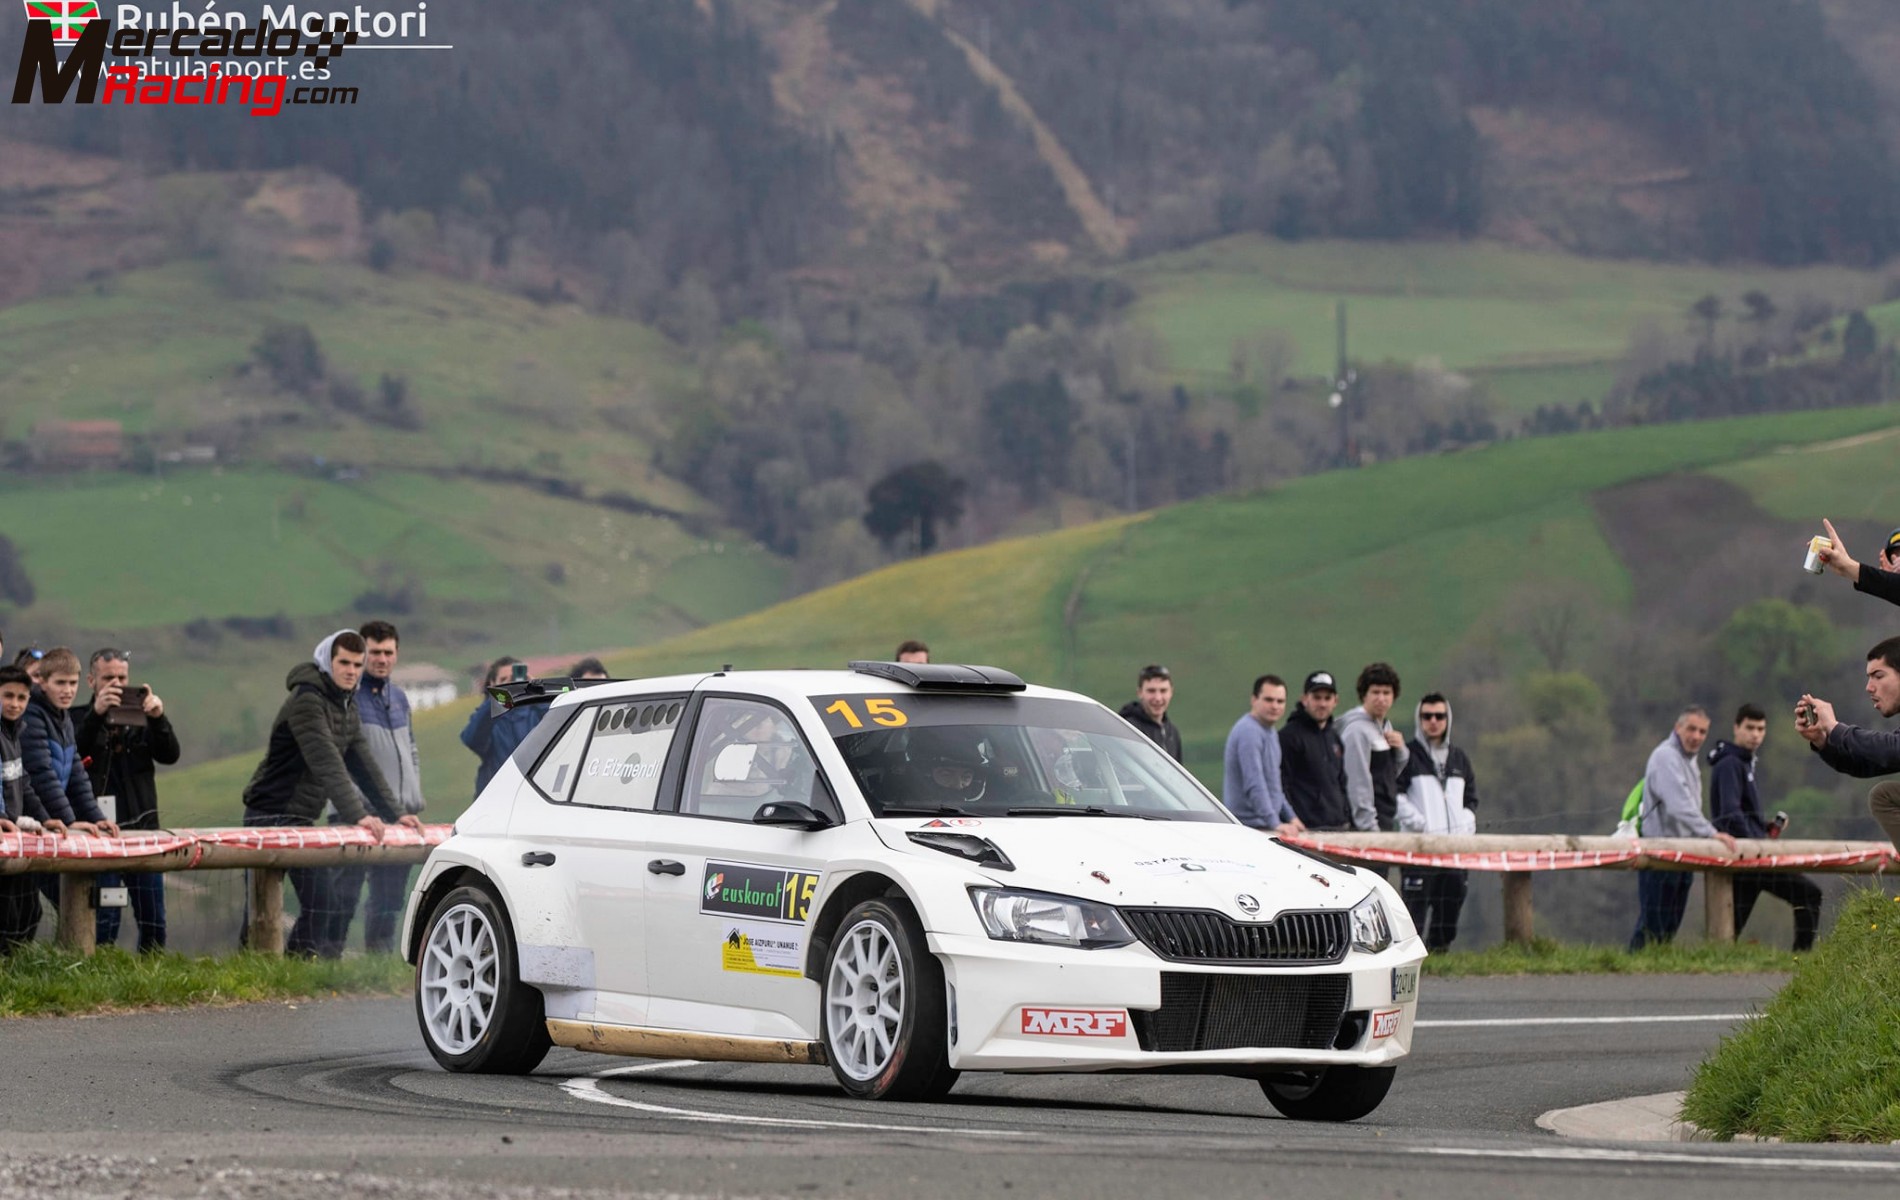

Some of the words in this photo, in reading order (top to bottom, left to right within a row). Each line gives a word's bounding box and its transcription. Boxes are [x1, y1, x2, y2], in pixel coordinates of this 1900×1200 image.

[825, 698, 908, 728] 15
[786, 873, 818, 921] 15
[1024, 1010, 1124, 1035] MRF
[1374, 1012, 1400, 1036] MRF
